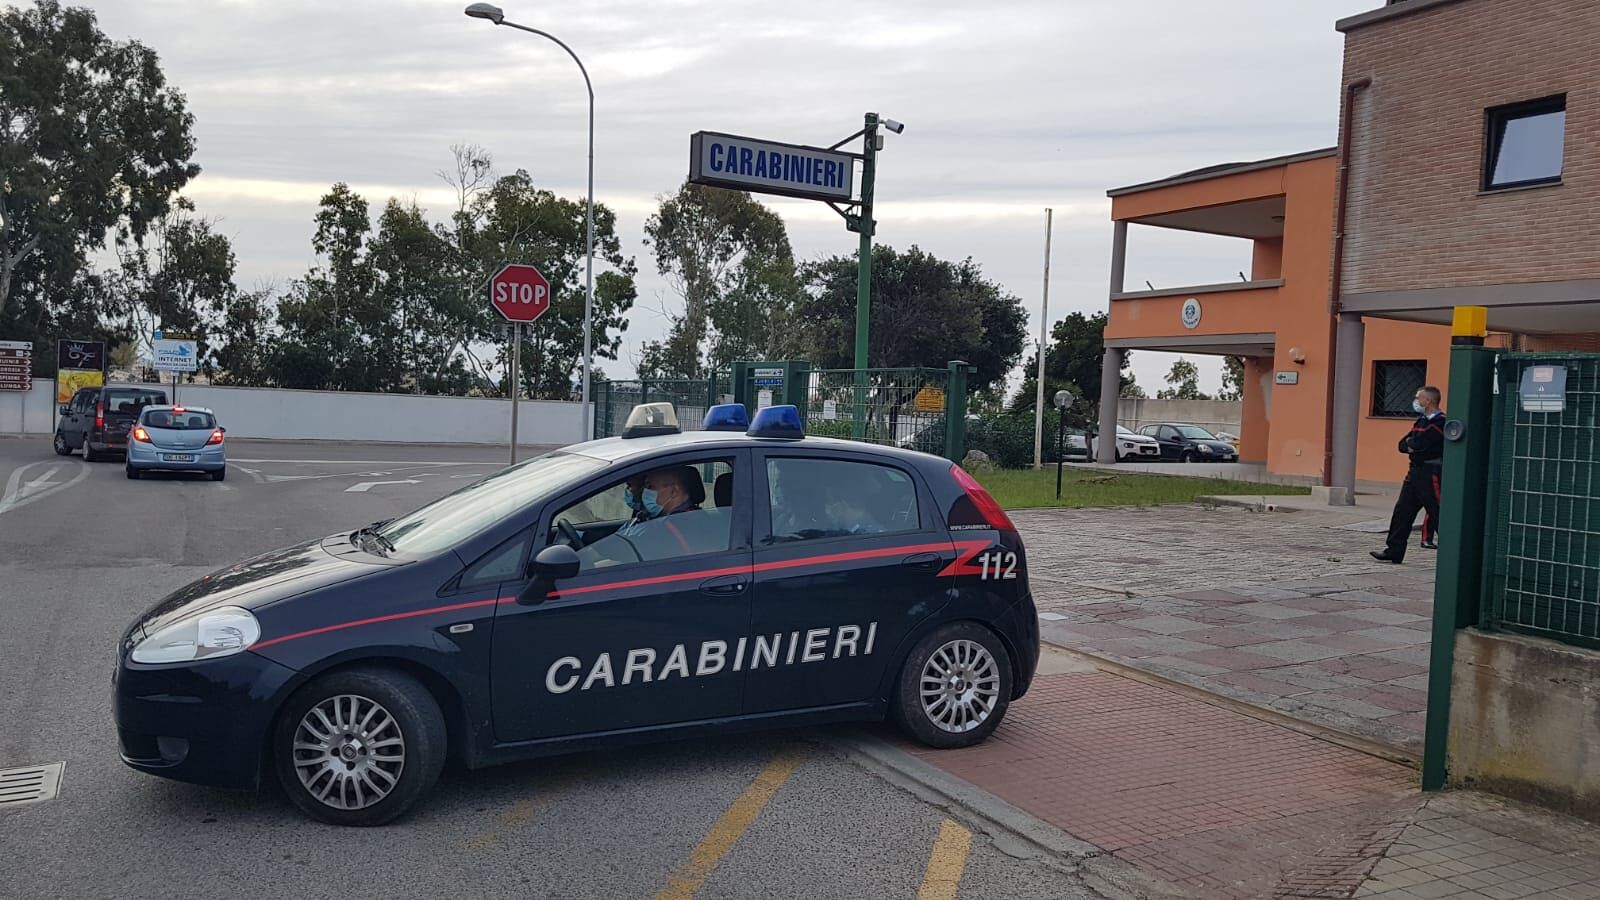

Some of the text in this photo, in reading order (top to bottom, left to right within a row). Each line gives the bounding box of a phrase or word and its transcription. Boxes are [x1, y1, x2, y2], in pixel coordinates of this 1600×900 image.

[710, 143, 844, 188] CARABINIERI
[496, 282, 546, 304] STOP
[978, 551, 1017, 580] 112
[545, 621, 878, 694] CARABINIERI
